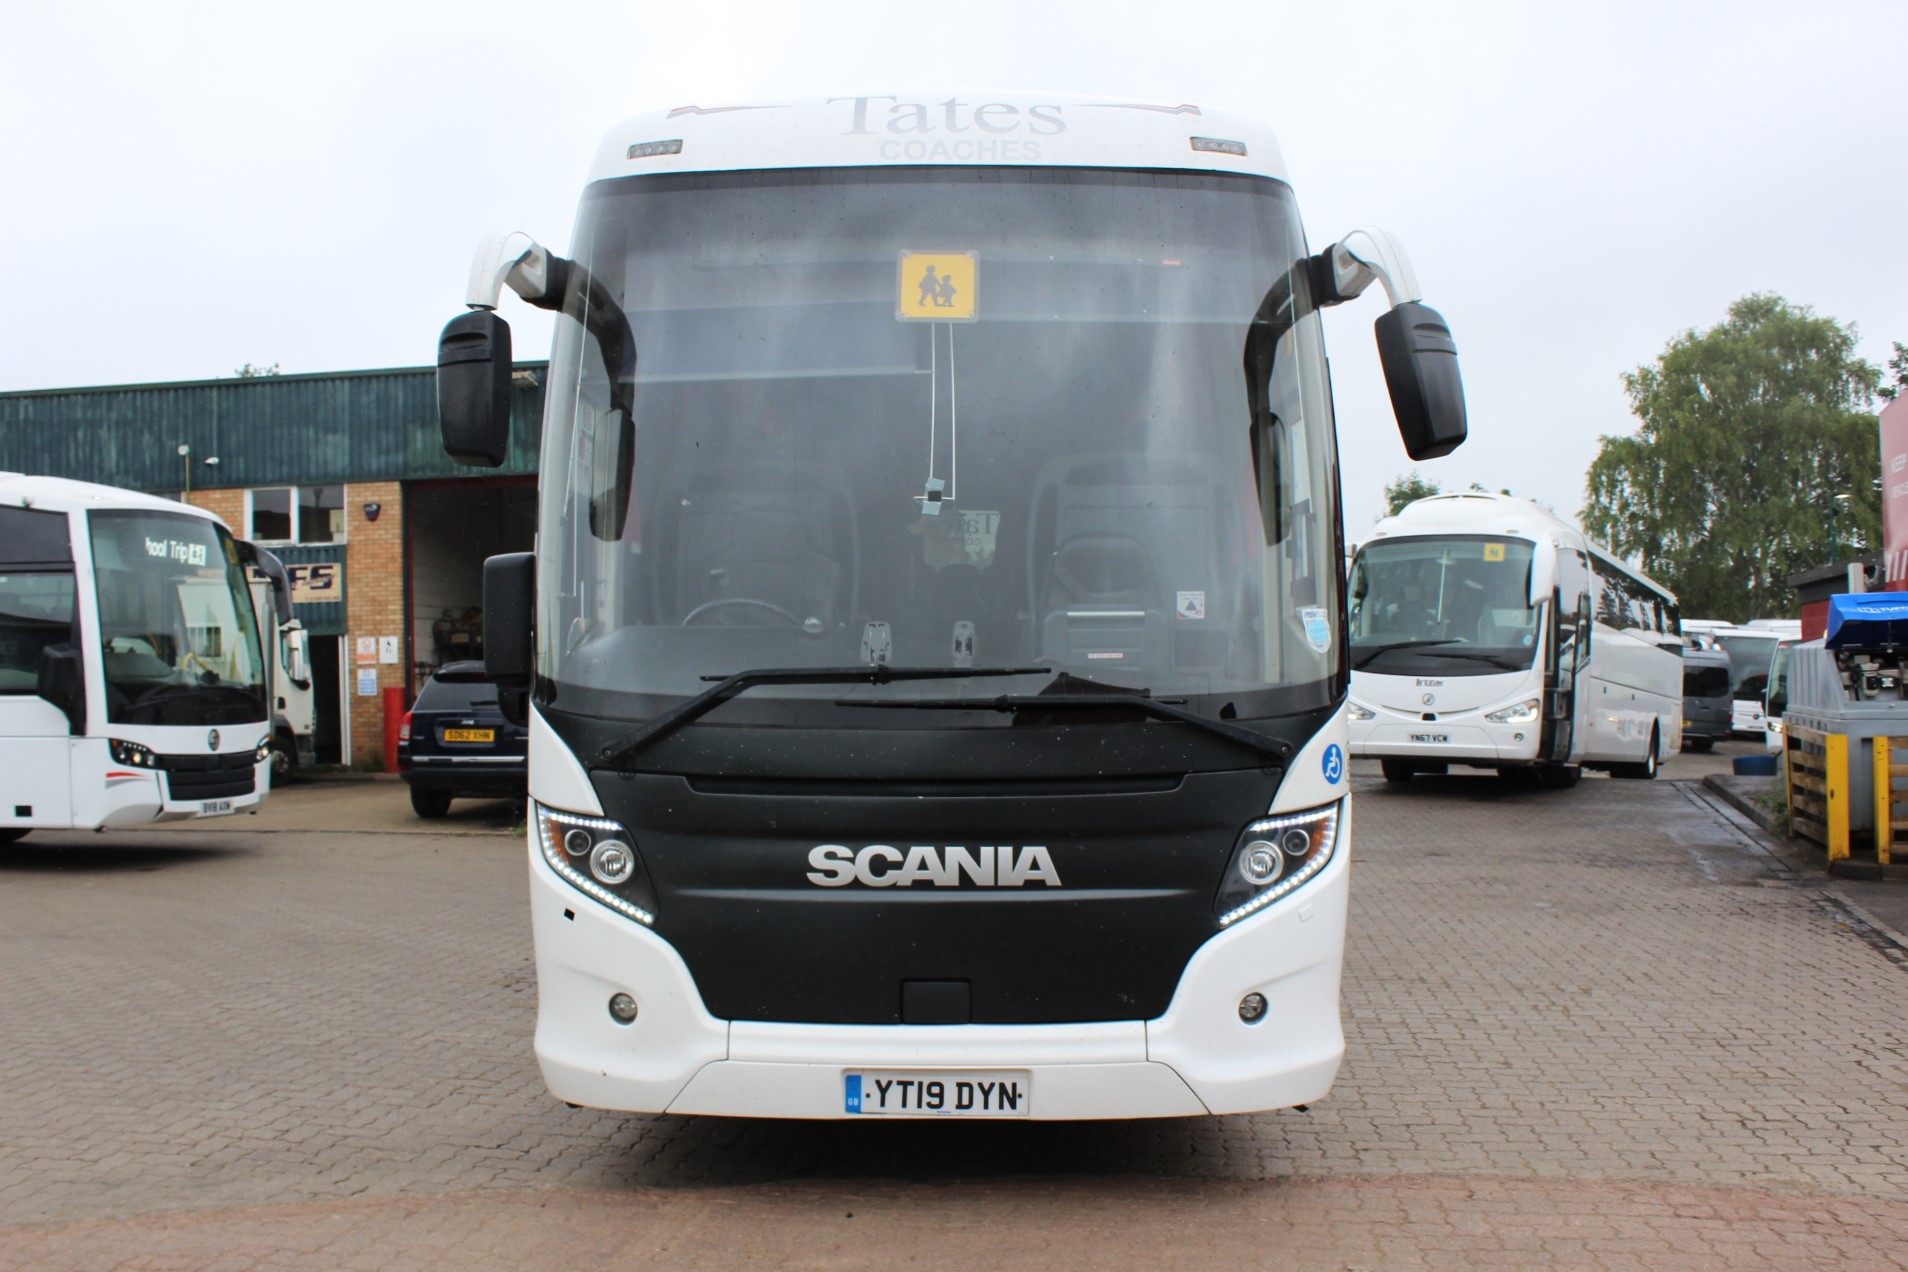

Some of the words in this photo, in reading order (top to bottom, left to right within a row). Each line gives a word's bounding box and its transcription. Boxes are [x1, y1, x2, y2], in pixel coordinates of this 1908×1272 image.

[826, 95, 1066, 135] Tates
[879, 139, 1042, 161] COACHES
[170, 540, 188, 563] Trip
[806, 844, 1062, 887] SCANIA
[875, 1079, 945, 1109] YT19
[955, 1081, 1017, 1110] DYN
